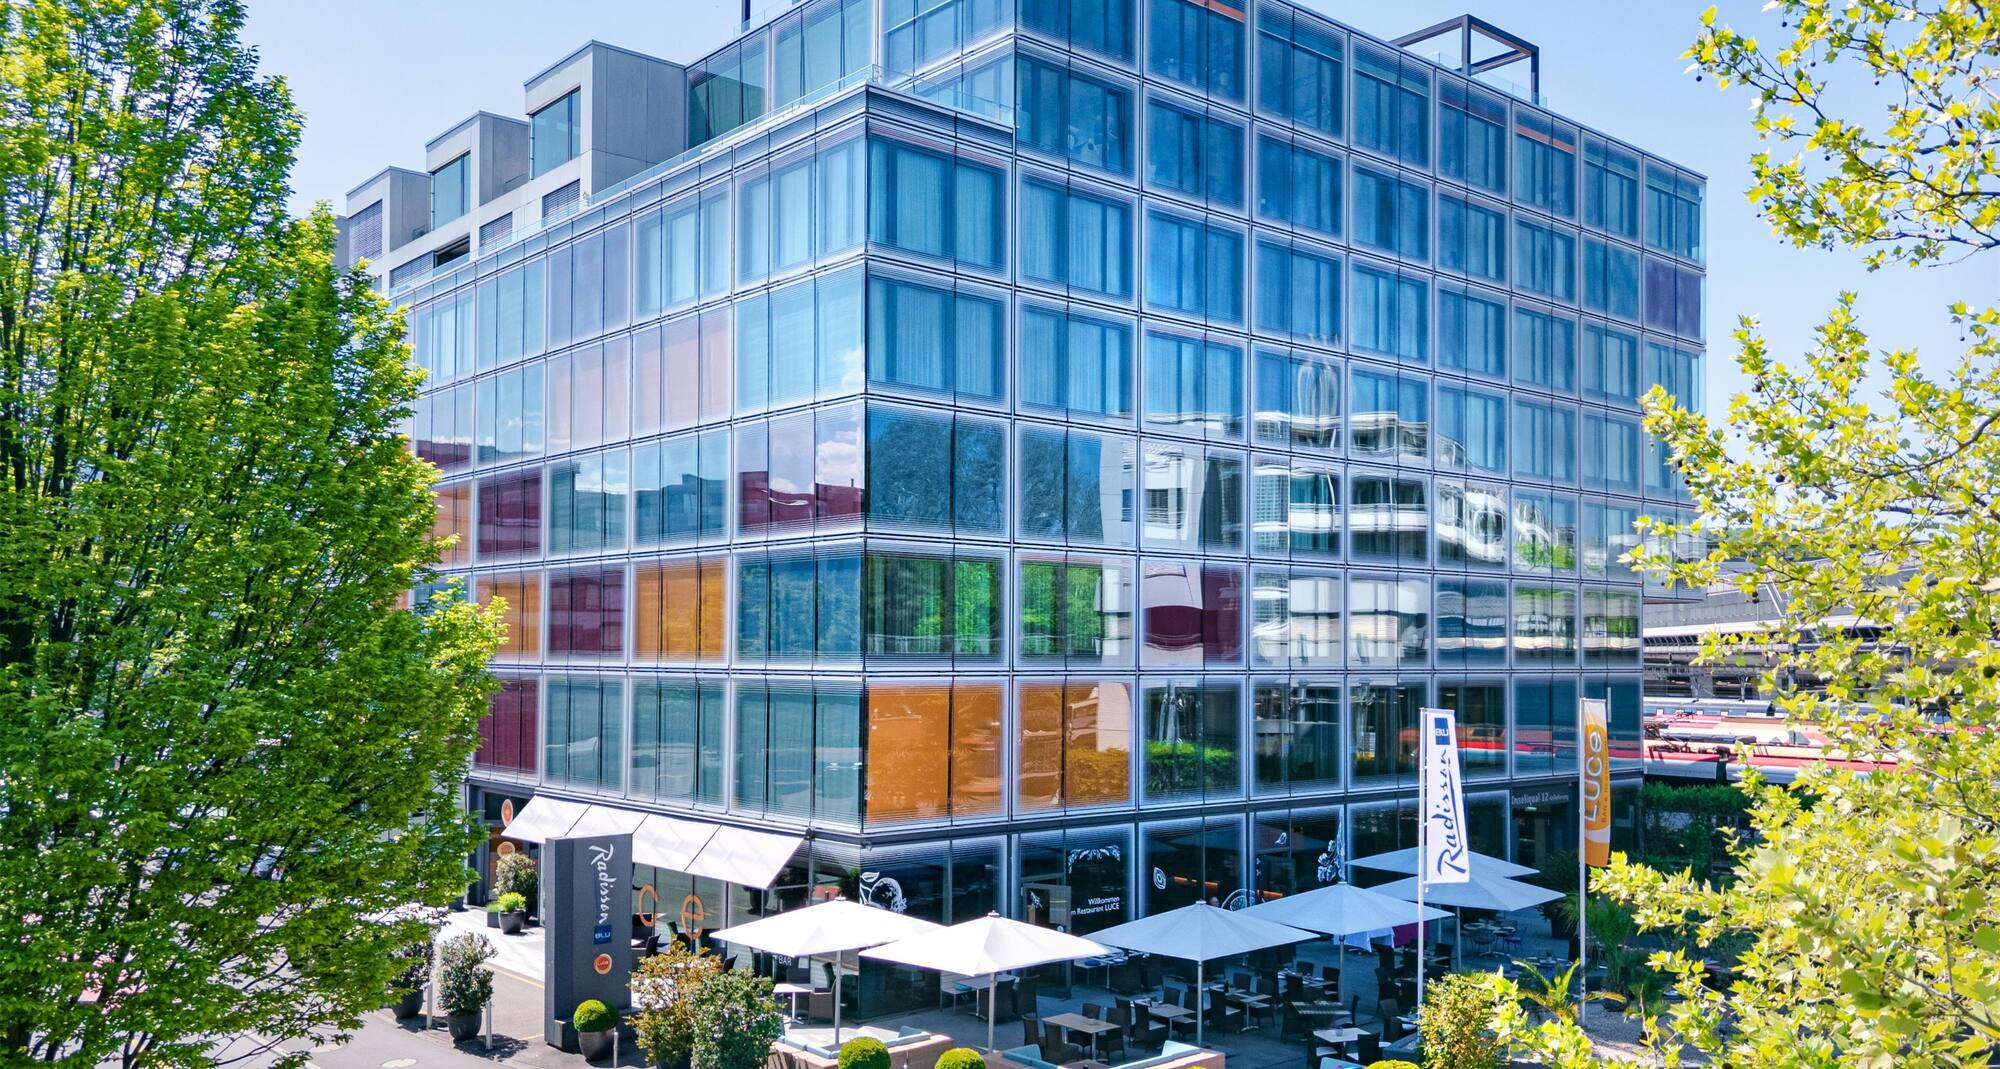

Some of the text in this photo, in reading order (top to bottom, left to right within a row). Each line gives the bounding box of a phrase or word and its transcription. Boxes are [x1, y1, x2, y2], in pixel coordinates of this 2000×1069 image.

[1541, 792, 1549, 802] 12
[1431, 748, 1467, 876] Radisson
[588, 843, 617, 925] Radisson
[1088, 896, 1120, 905] Willkommen
[1077, 906, 1104, 915] Restaurant
[1105, 902, 1120, 911] LUCE
[594, 930, 611, 939] BLU
